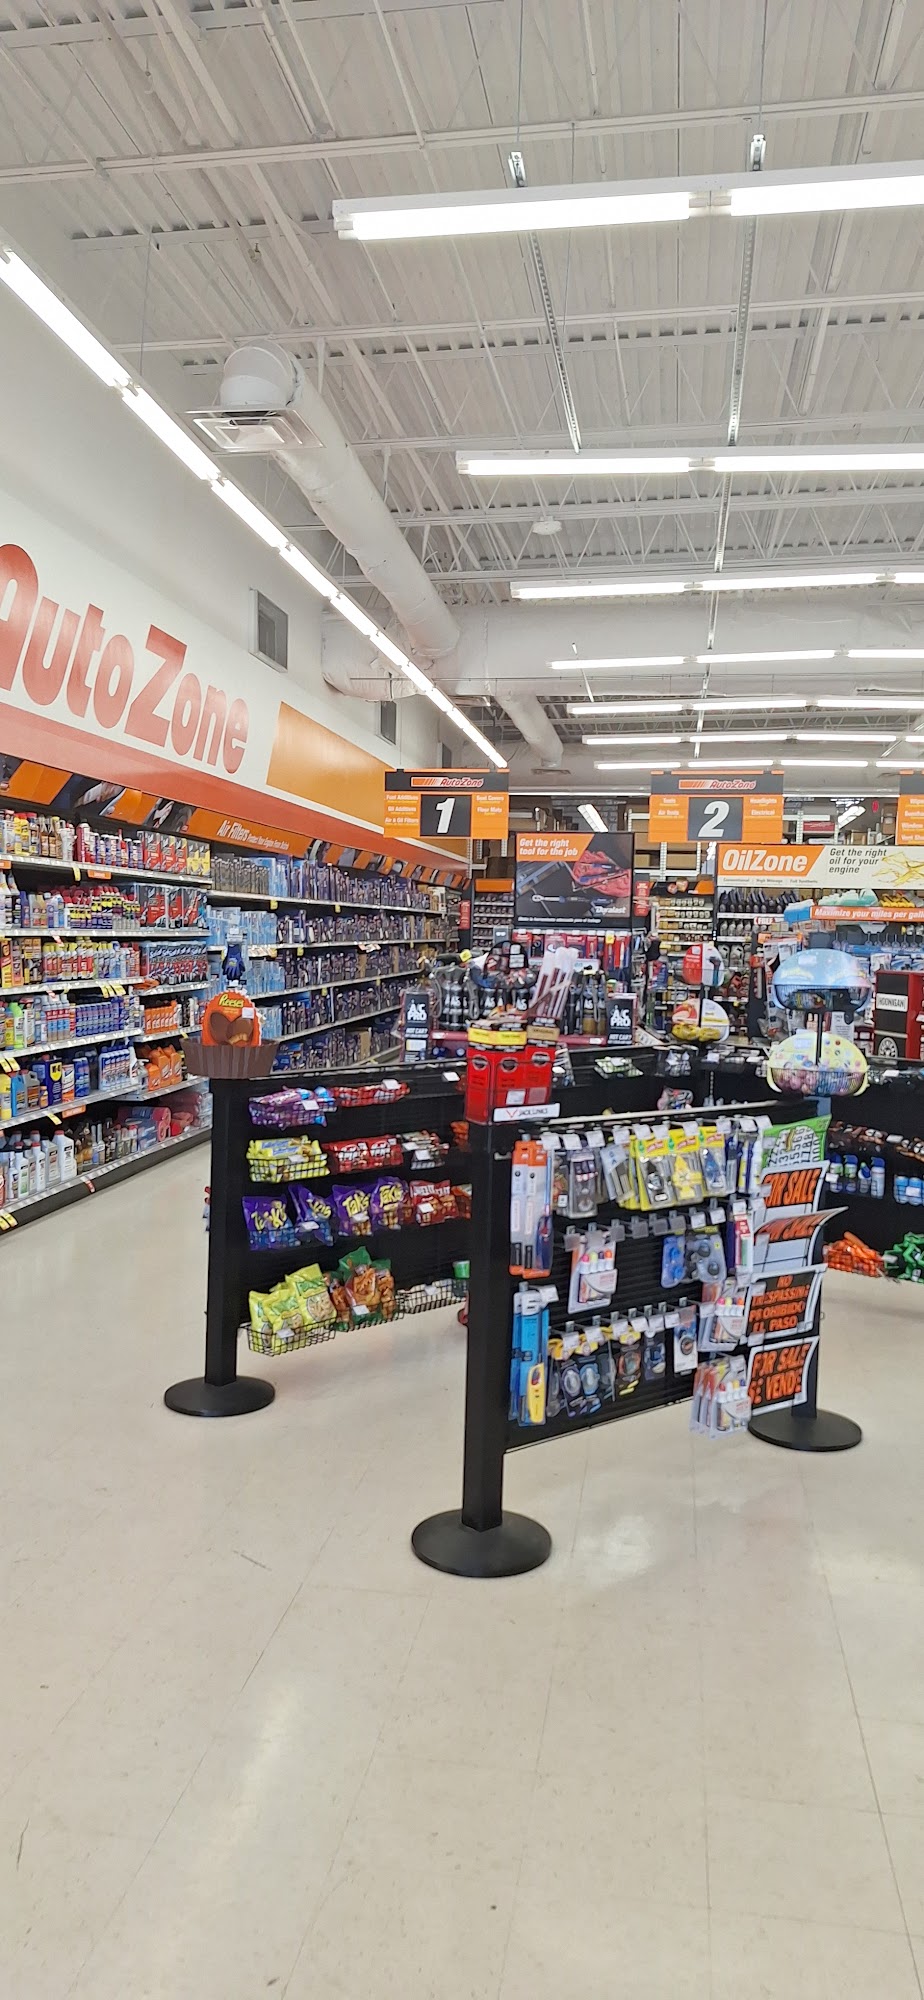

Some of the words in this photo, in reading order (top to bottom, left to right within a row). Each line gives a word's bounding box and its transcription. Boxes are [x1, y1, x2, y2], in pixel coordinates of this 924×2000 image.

[440, 778, 483, 787] AutoZone
[709, 780, 757, 789] AutoZone
[435, 797, 456, 834] 1
[698, 800, 730, 837] 2
[217, 819, 232, 837] Air
[228, 822, 250, 841] Filters
[520, 838, 533, 847] Get
[535, 838, 548, 847] the
[549, 839, 569, 849] right
[520, 847, 535, 855] tool
[536, 847, 548, 855] for
[549, 848, 563, 856] the
[564, 848, 578, 857] job
[829, 848, 845, 856] Get
[847, 848, 863, 856] the
[864, 849, 887, 859] right
[722, 849, 808, 872] OilZone
[829, 857, 841, 865] oil
[842, 857, 857, 865] for
[858, 859, 879, 867] your
[828, 867, 860, 875] engine
[814, 908, 850, 917] Maximize
[851, 910, 870, 919] your
[871, 909, 892, 918] miles
[893, 911, 908, 919] per
[877, 996, 906, 1009] HOONIGAN
[407, 1012, 427, 1021] PRO
[610, 1017, 631, 1027] PRO
[777, 1275, 794, 1288] NO
[749, 1301, 805, 1322] PROHIBIDO
[769, 1315, 797, 1331] PASO
[752, 1351, 777, 1378] FOR
[777, 1343, 811, 1371] SALE
[766, 1367, 803, 1400] VENDE
